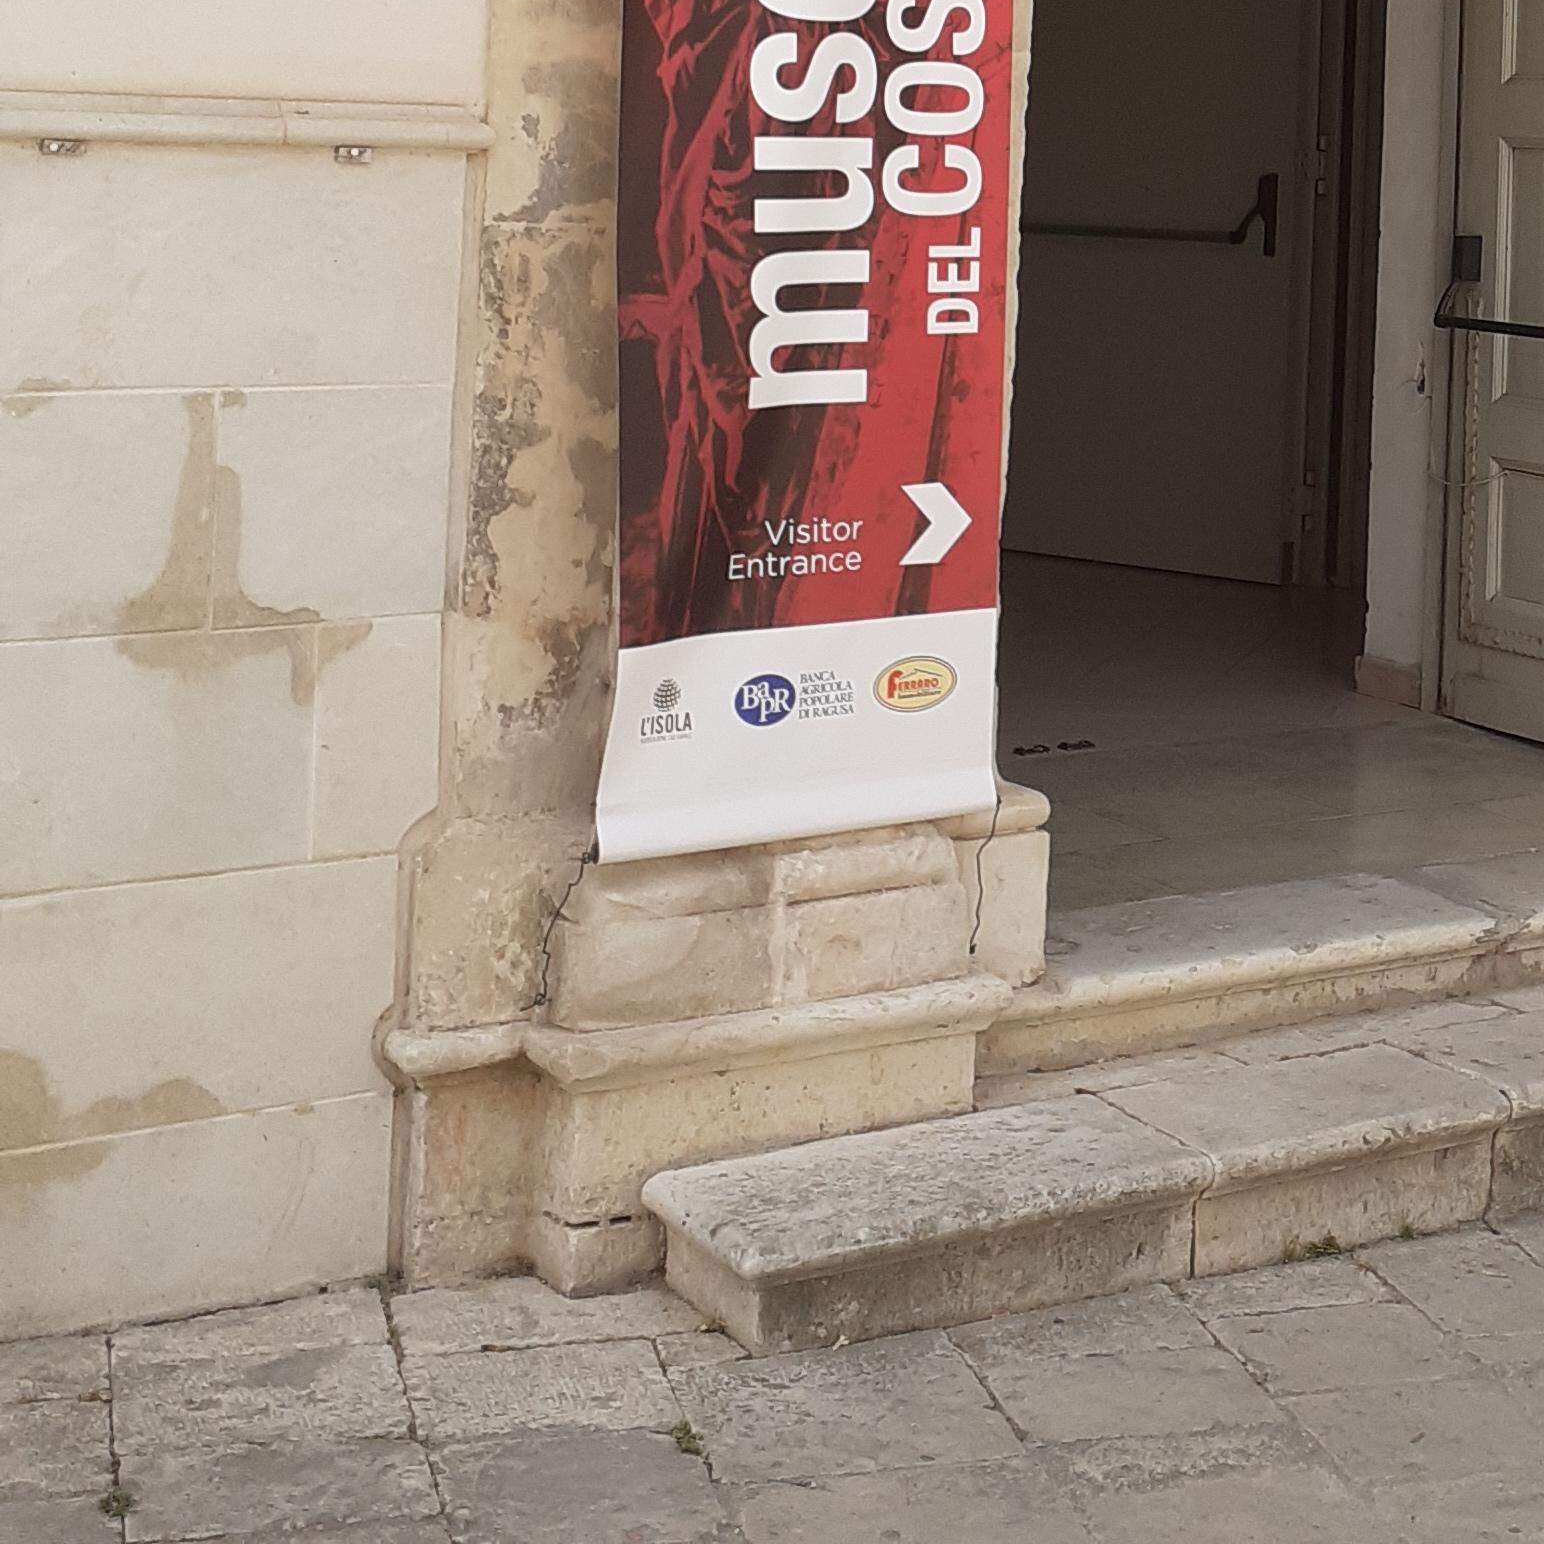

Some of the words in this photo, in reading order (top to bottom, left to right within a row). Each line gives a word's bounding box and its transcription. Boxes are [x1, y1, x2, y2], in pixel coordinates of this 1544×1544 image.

[926, 226, 981, 337] DEL
[765, 517, 863, 546] Visitor
[728, 550, 862, 580] Entrance
[800, 670, 835, 684] BANCA
[799, 680, 853, 696] AGRICOLA
[799, 692, 854, 707] POPOLARE
[799, 706, 810, 720] DI
[813, 705, 855, 719] RAGUSA
[640, 712, 692, 737] L'ISOLA
